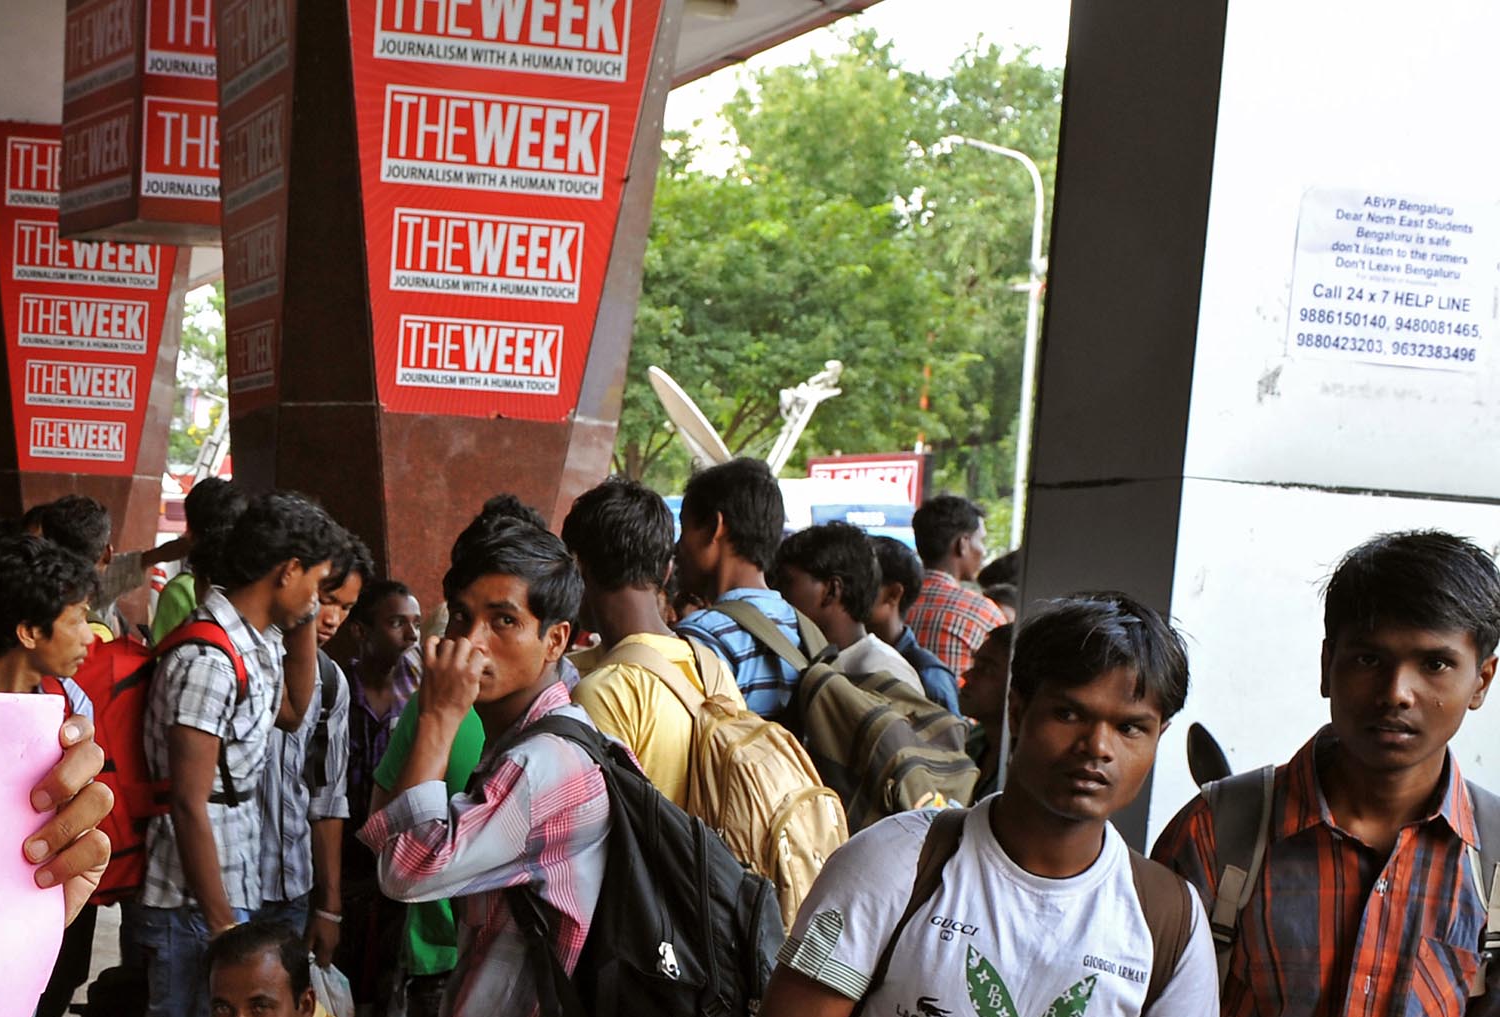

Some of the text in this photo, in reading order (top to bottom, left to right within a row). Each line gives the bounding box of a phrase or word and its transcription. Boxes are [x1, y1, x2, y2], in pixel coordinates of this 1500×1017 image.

[379, 38, 621, 76] JOURNALISM WITH A HUMAN TOUCH
[386, 164, 599, 195] JOURNALISM WITH A HUMAN TOUCH
[1364, 196, 1454, 216] ABVP Bengaluru
[1336, 209, 1474, 234] Dear North East Students
[1356, 227, 1452, 247] Bengaluru is safe
[1363, 244, 1394, 256] listen
[1397, 248, 1407, 258] to
[1410, 249, 1428, 260] the
[16, 268, 155, 286] JOURNALISM WITH A HUMAN TOUCH
[1335, 256, 1366, 270] Don't
[1368, 260, 1401, 273] Leave
[1405, 263, 1461, 280] Bengaluru
[394, 275, 575, 300] JOURNALISM WITH A HUMAN TOUCH
[1312, 283, 1471, 312] Call 24 x 7 HELP LINE
[1391, 341, 1476, 362] 9632383496
[400, 372, 556, 391] JOURNALISM WITH A HUMAN TOUCH
[930, 914, 981, 938] GUCCI
[1083, 954, 1118, 975] GIORGIO
